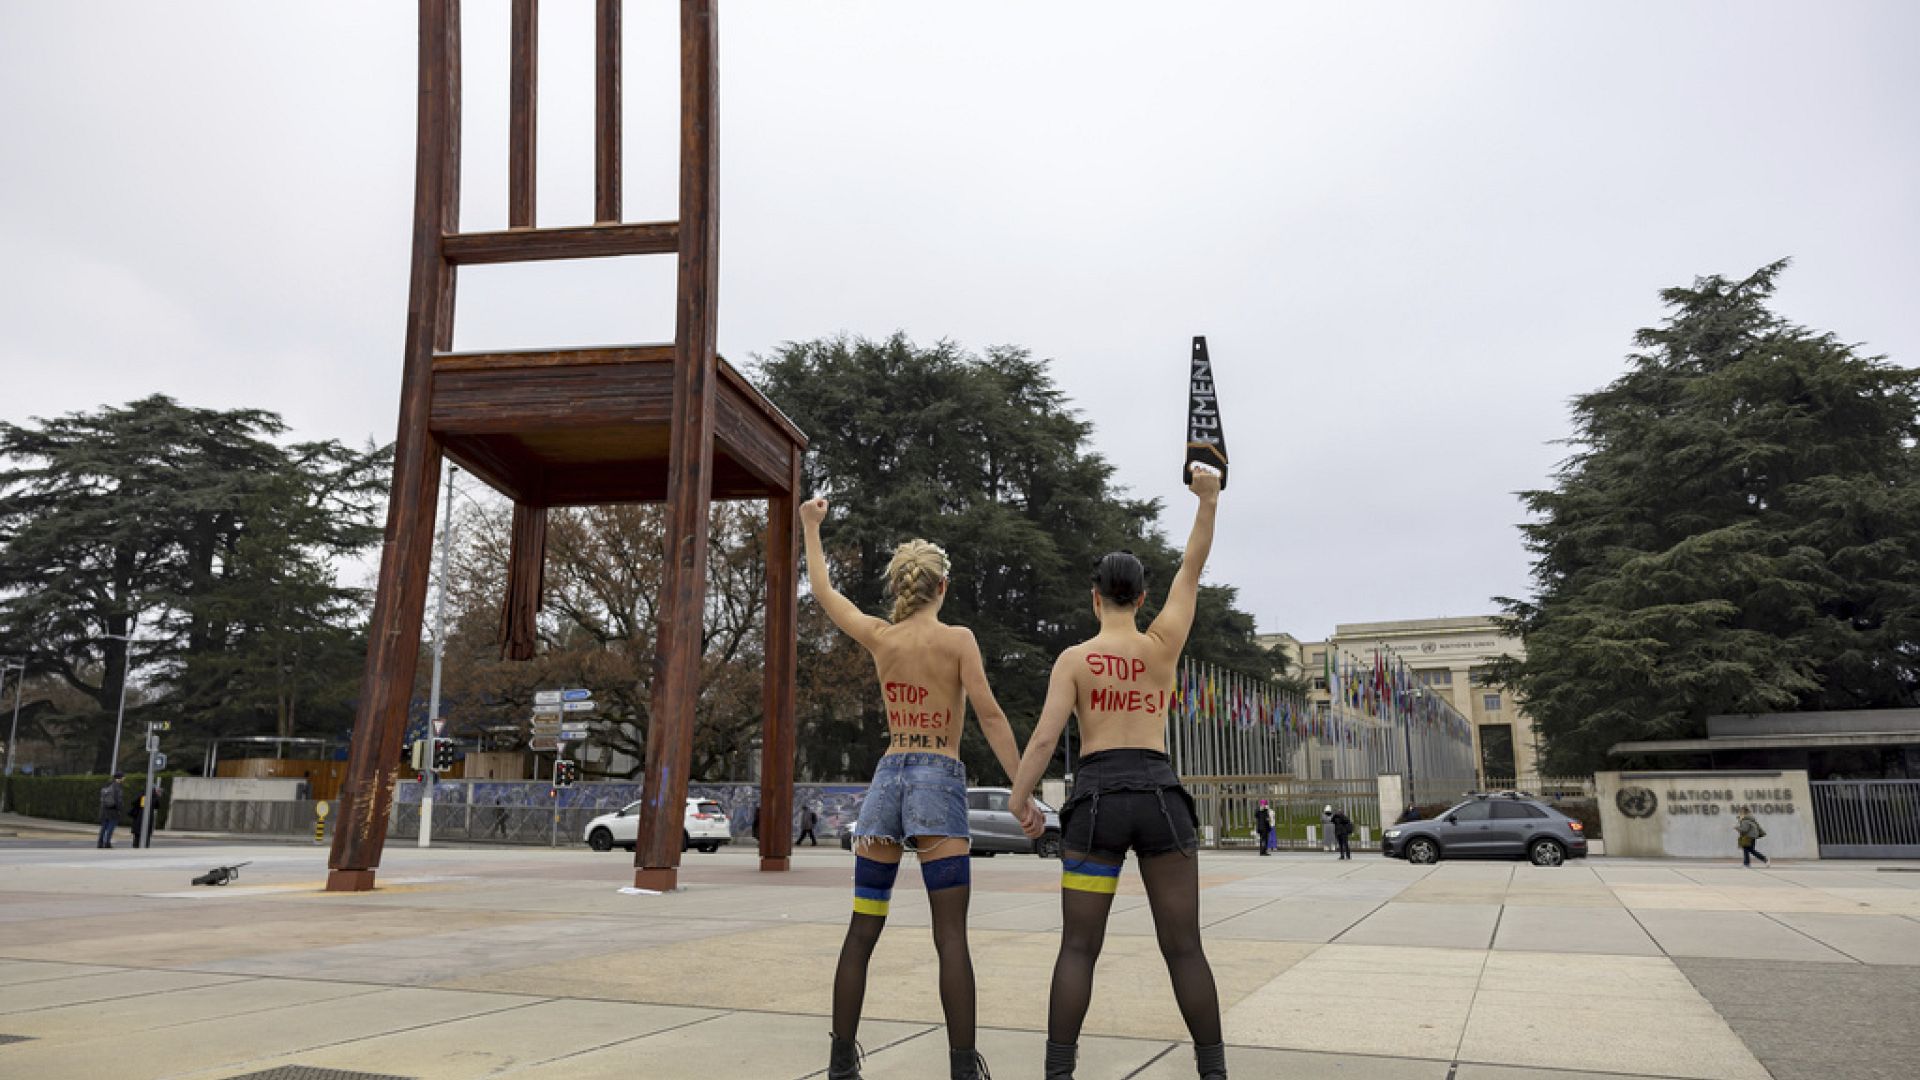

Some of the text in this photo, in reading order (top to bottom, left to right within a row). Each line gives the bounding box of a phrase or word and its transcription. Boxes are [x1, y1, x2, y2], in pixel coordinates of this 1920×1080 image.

[1191, 359, 1219, 443] FEMEN
[1086, 653, 1146, 682] STOP
[885, 681, 929, 705] STOP
[891, 733, 949, 749] FEMEN
[1666, 788, 1793, 801] NATIONS UNIES
[1668, 803, 1795, 815] UNITED NTIONS
